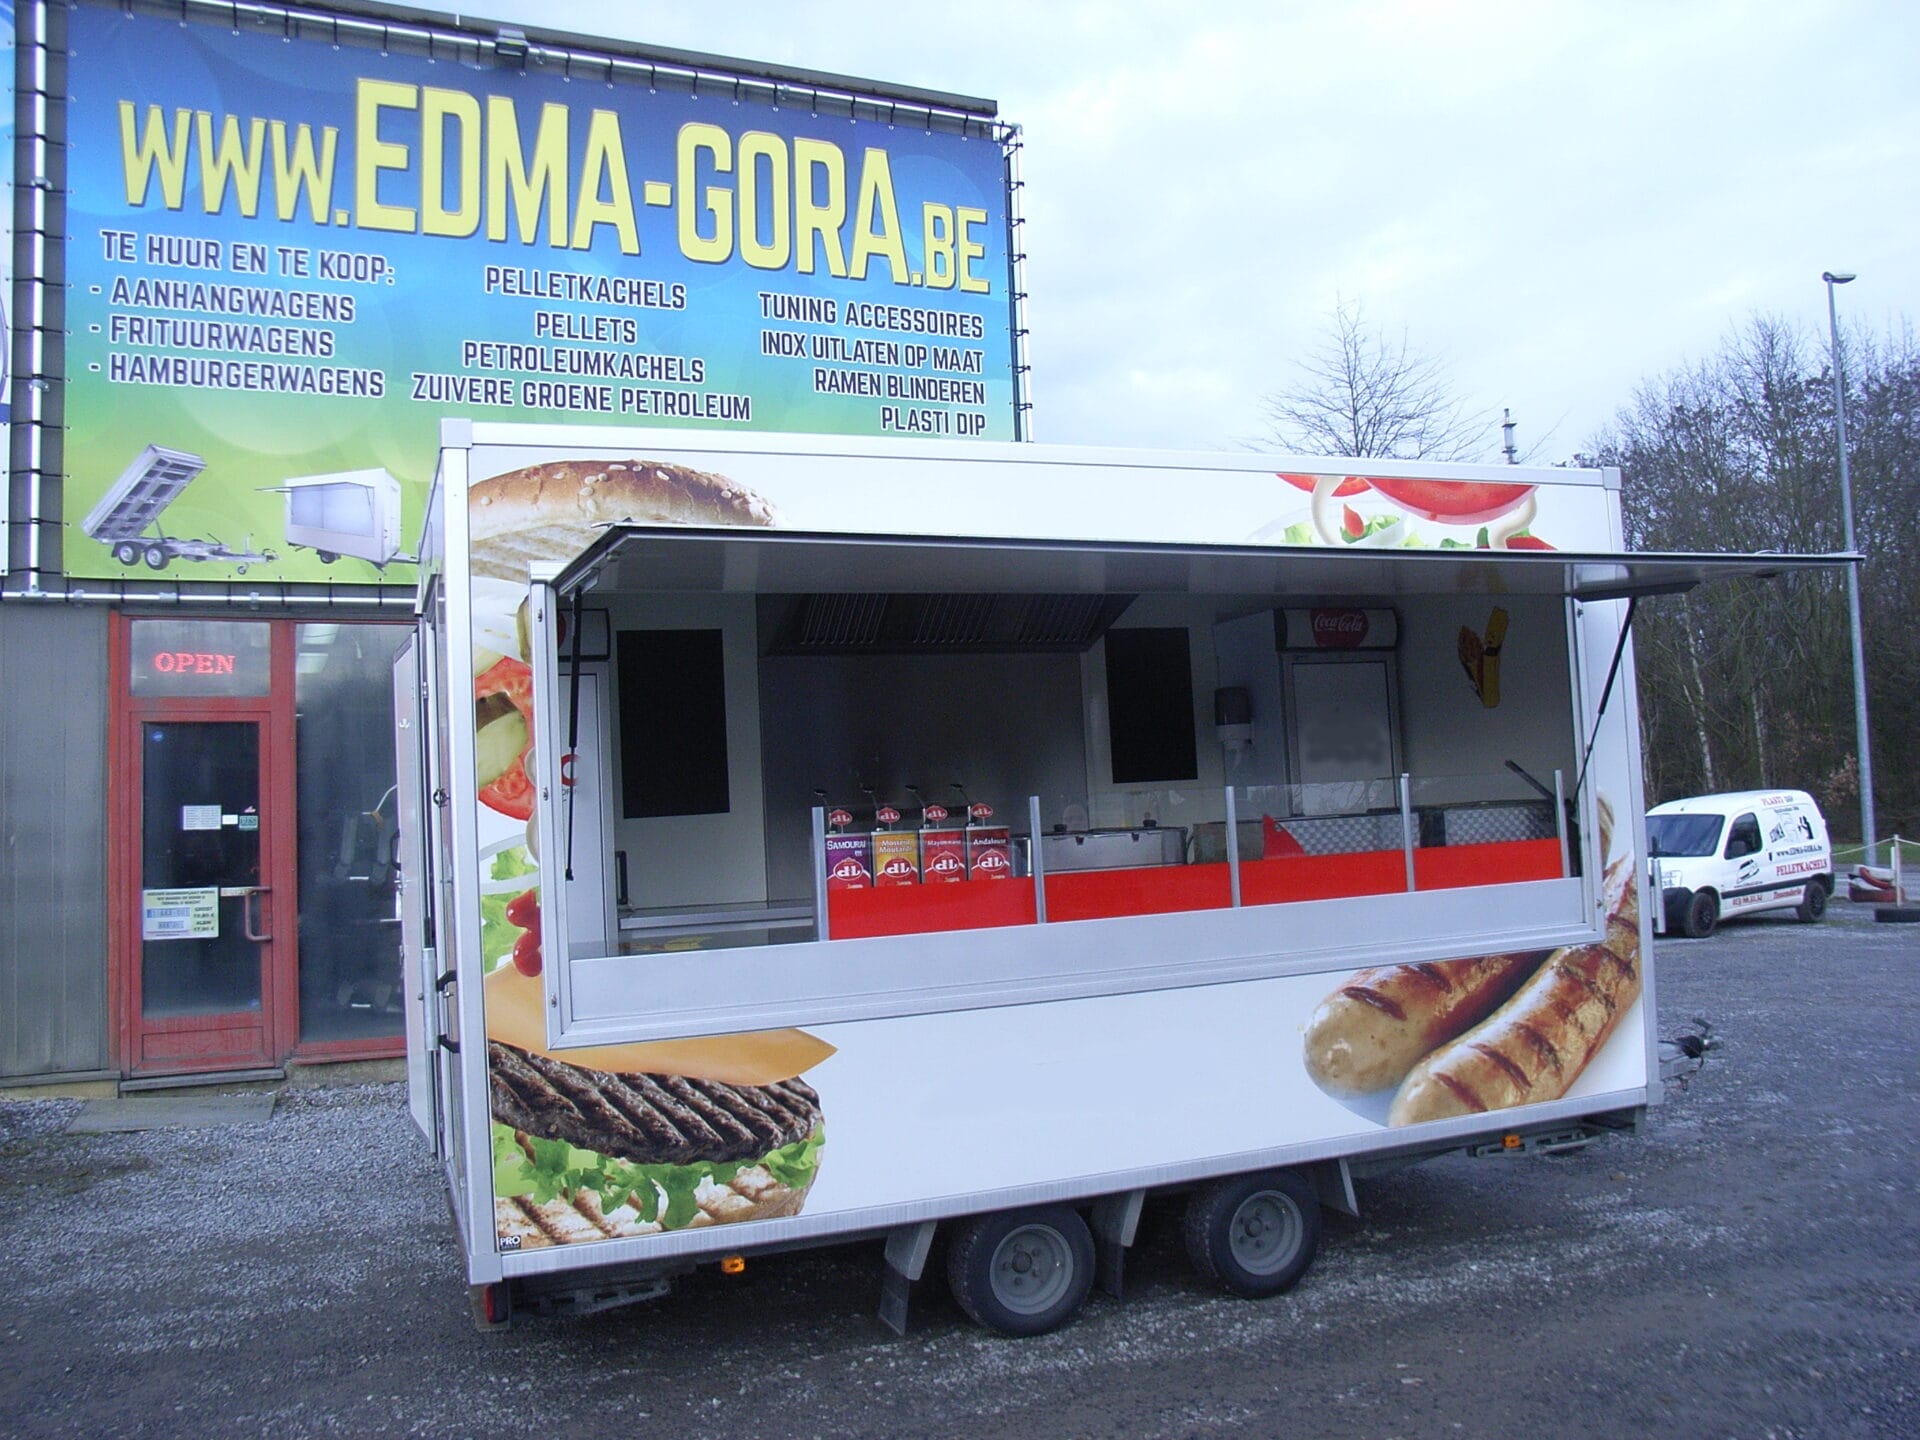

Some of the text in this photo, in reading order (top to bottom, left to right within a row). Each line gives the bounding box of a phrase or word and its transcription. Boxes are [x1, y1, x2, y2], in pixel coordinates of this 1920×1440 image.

[102, 230, 395, 285] TE HUUR EN TE KOOP:
[112, 278, 354, 322] AANHANGWAGENS
[486, 267, 686, 309] PELLETKACHELS
[537, 312, 637, 343] PELLETS
[760, 293, 983, 338] TUNING ACCESSOIRES
[110, 316, 335, 357] FRITUURWAGENS
[762, 331, 983, 373] INOX UITLATEN OP MAAT
[110, 355, 385, 398] HAMBURGERWAGENS
[464, 342, 704, 383] PETROLEUMKACHELS
[412, 373, 751, 421] ZUIVERE GROENE PETROLEUM
[816, 369, 985, 405] RAMEN BLINDEREN
[882, 407, 986, 437] PLASTI DIP
[154, 652, 236, 675] OPEN
[827, 840, 866, 850] SAMOURAI
